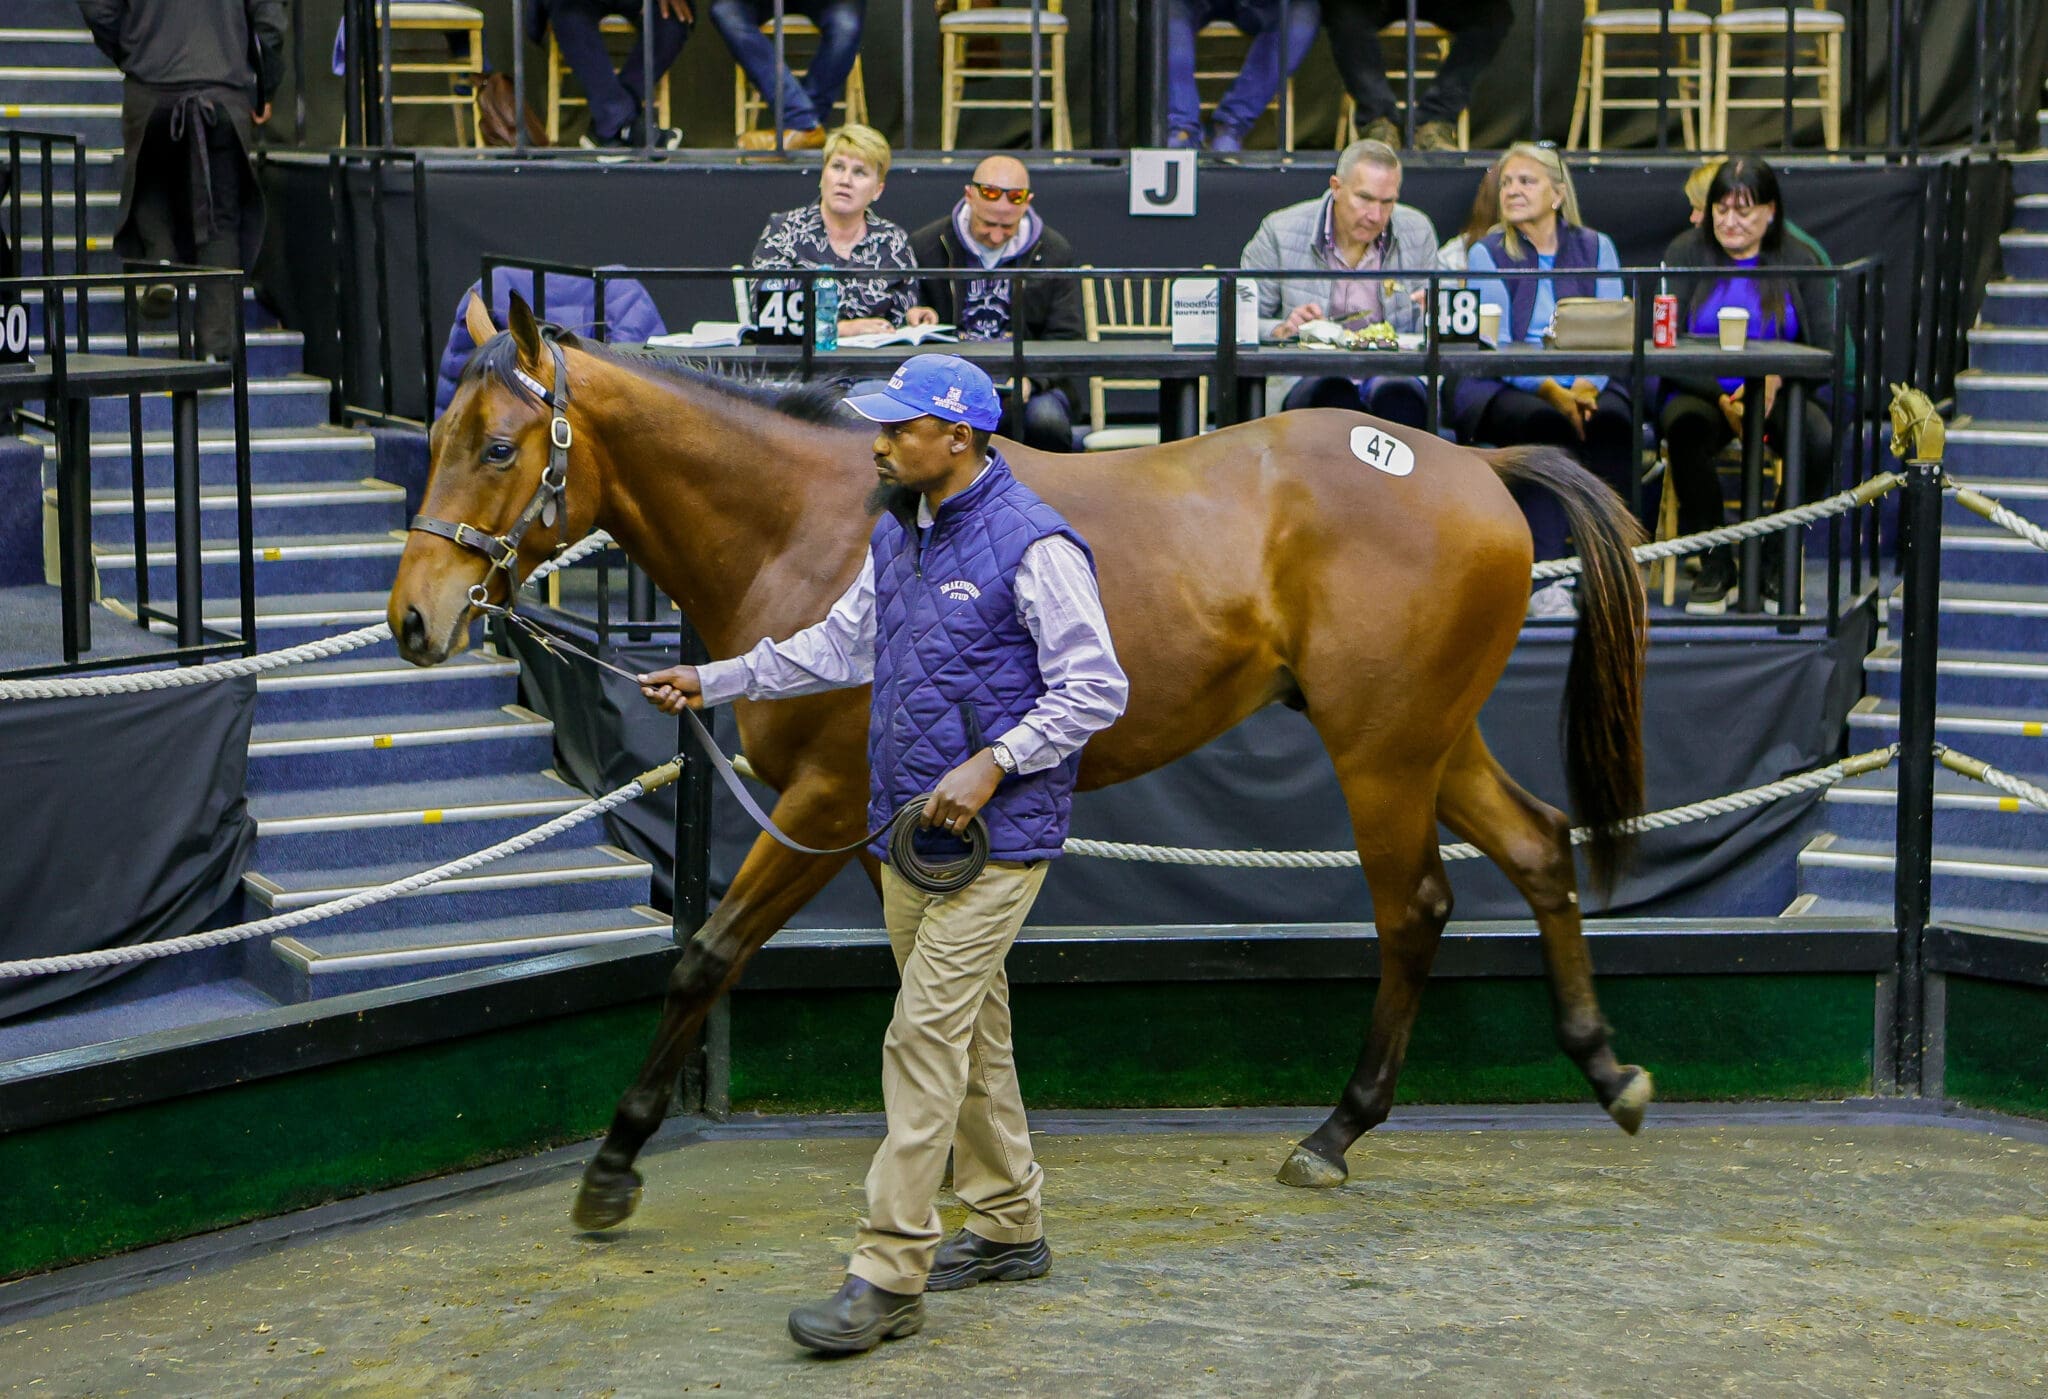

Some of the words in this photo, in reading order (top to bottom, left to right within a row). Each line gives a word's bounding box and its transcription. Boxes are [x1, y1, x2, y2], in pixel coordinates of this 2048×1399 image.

[1143, 161, 1179, 206] J
[759, 291, 804, 336] 49
[1174, 300, 1217, 308] BloodSto
[1425, 290, 1478, 335] 48
[0, 304, 27, 354] 0
[1367, 434, 1396, 466] 47
[940, 581, 981, 599] DRAKENSTEIN
[949, 592, 969, 601] STUD
